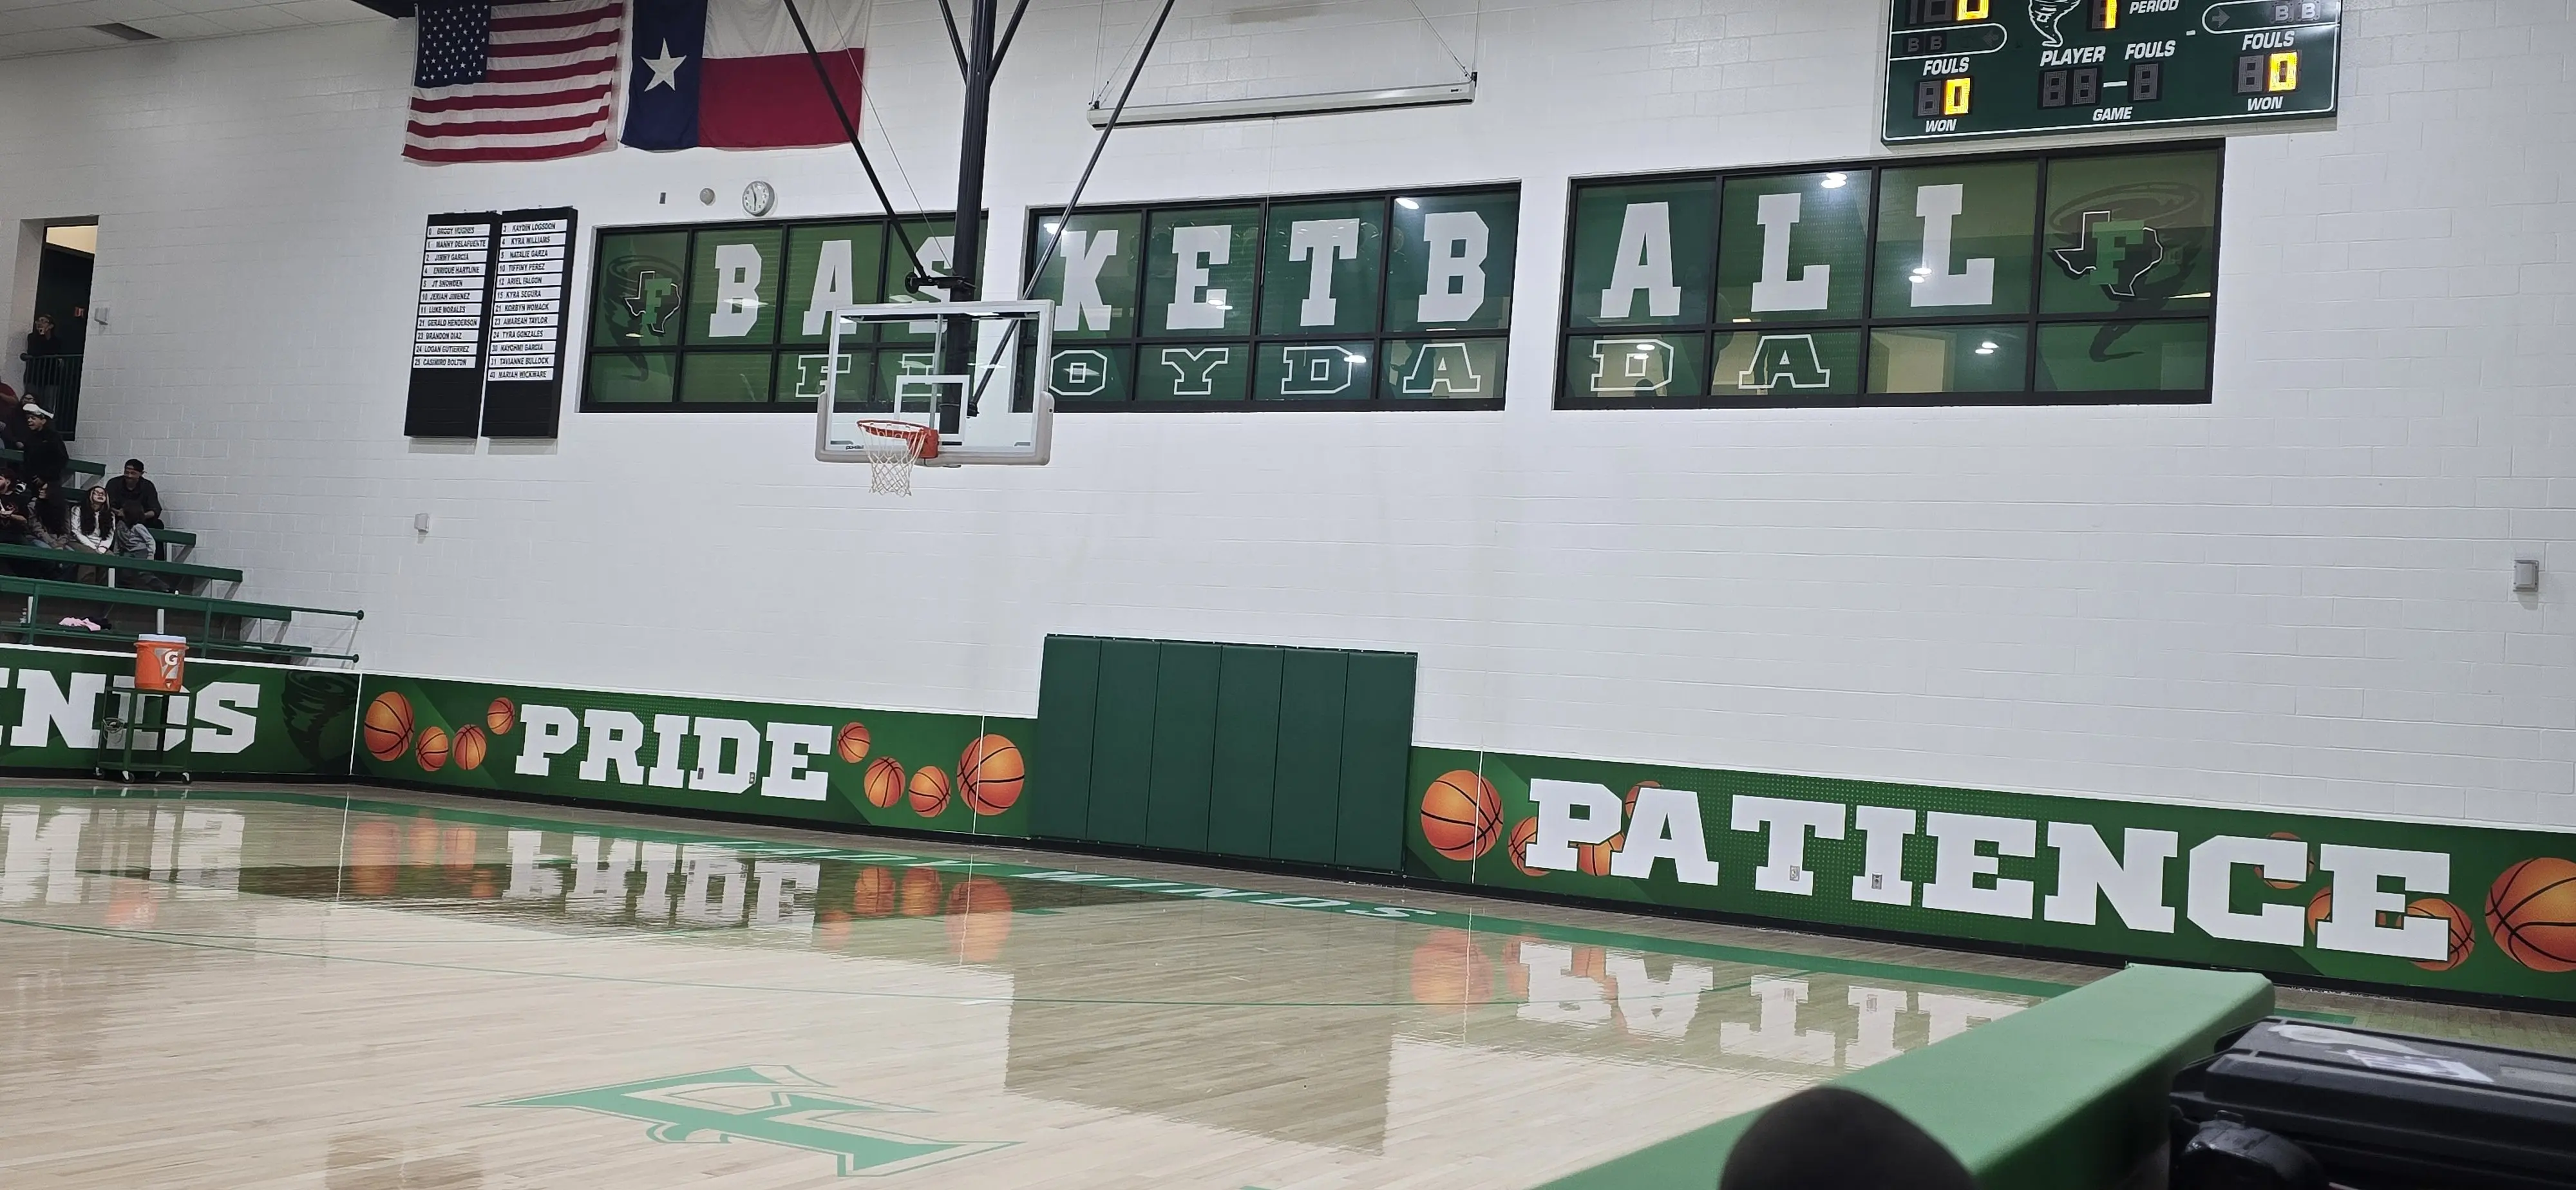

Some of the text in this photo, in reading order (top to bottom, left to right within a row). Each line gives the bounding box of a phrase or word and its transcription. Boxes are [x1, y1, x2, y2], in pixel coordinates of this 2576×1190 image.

[2129, 0, 2179, 14] PERIOD
[2242, 30, 2295, 51] FOULS
[2040, 40, 2176, 67] PLAYER FOULS
[1923, 57, 1970, 76] FOULS
[2248, 96, 2284, 111] WON
[2094, 106, 2133, 122] GAME
[1925, 118, 1957, 133] WON
[164, 651, 178, 666] G
[0, 667, 260, 753] NDS
[515, 704, 833, 801] PRIDE
[1525, 778, 2450, 961] PATIENCE
[1009, 871, 1436, 918] WINDS
